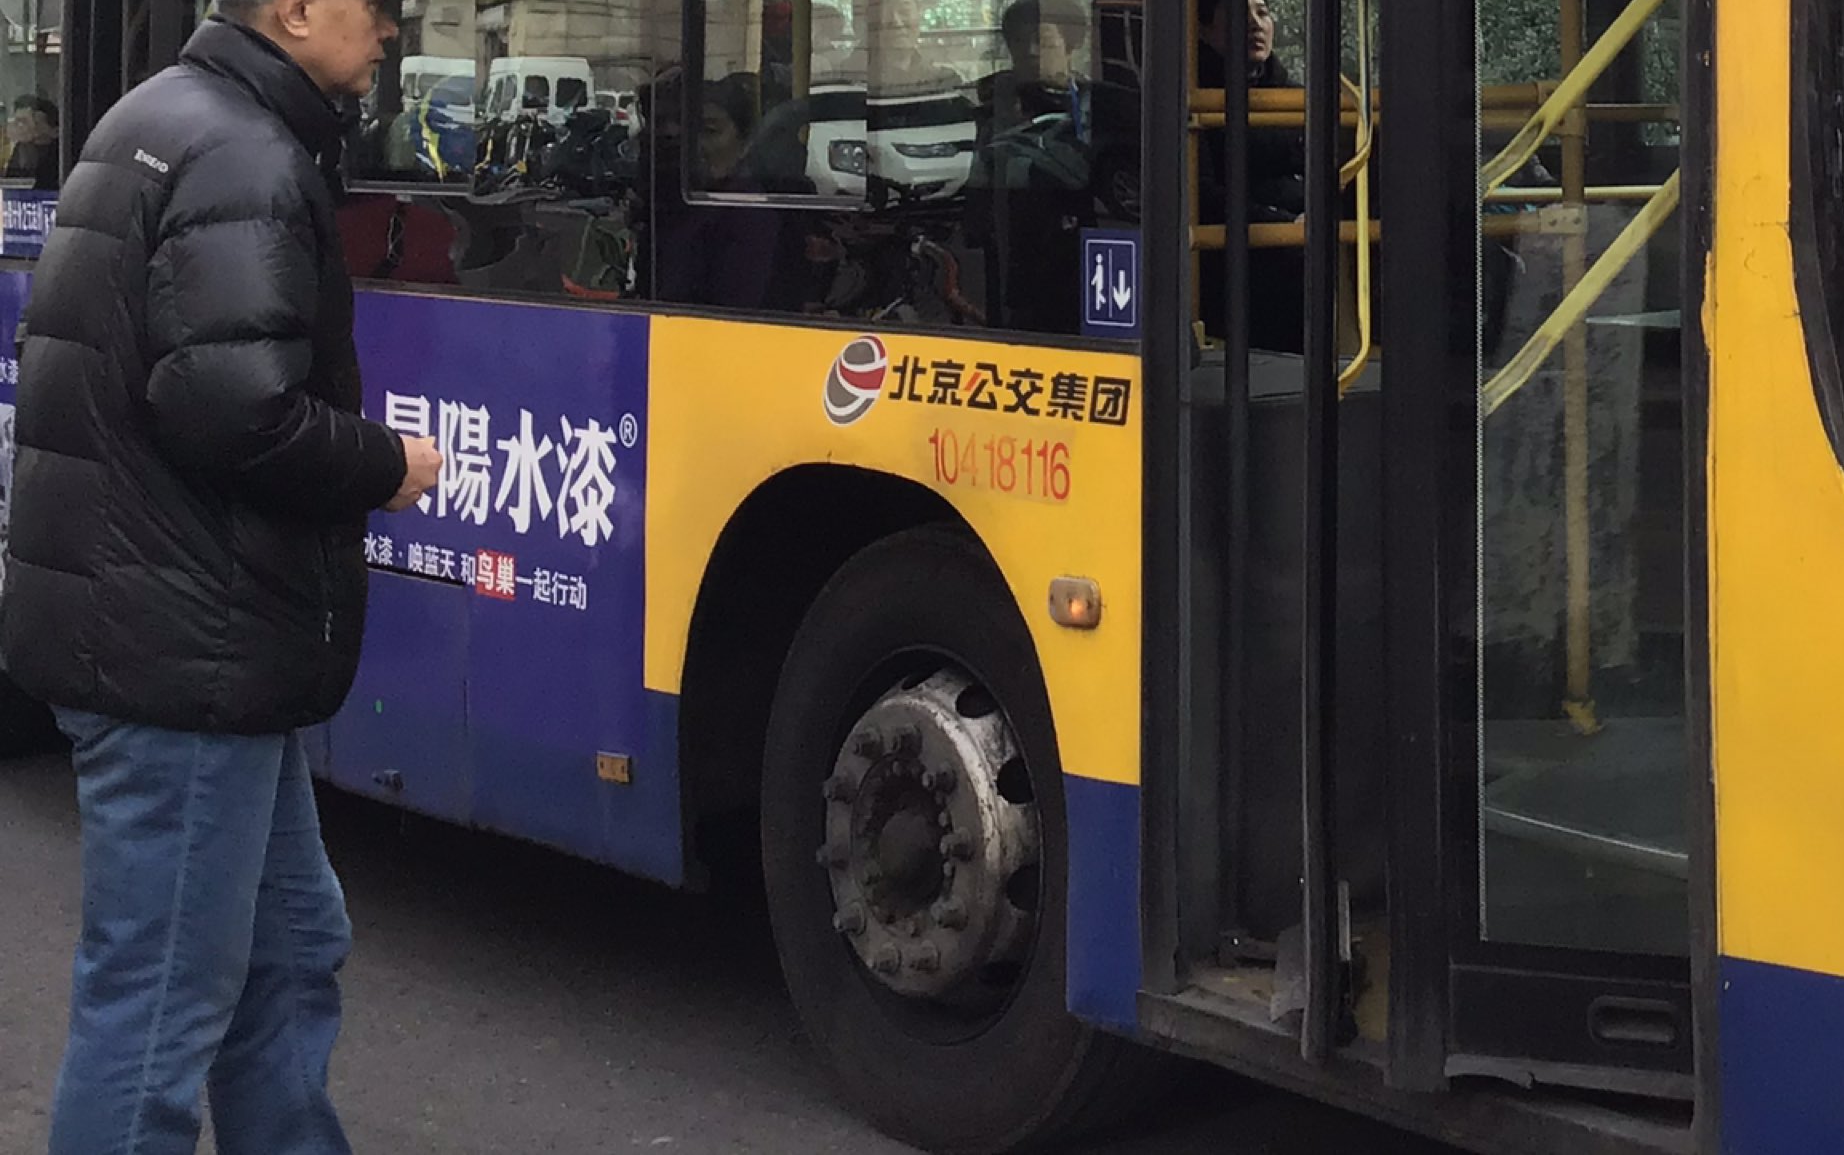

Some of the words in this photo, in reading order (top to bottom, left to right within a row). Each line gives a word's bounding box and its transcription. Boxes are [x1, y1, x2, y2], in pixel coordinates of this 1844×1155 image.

[888, 355, 1132, 427] 北京公交集团
[928, 427, 1071, 501] 10418116
